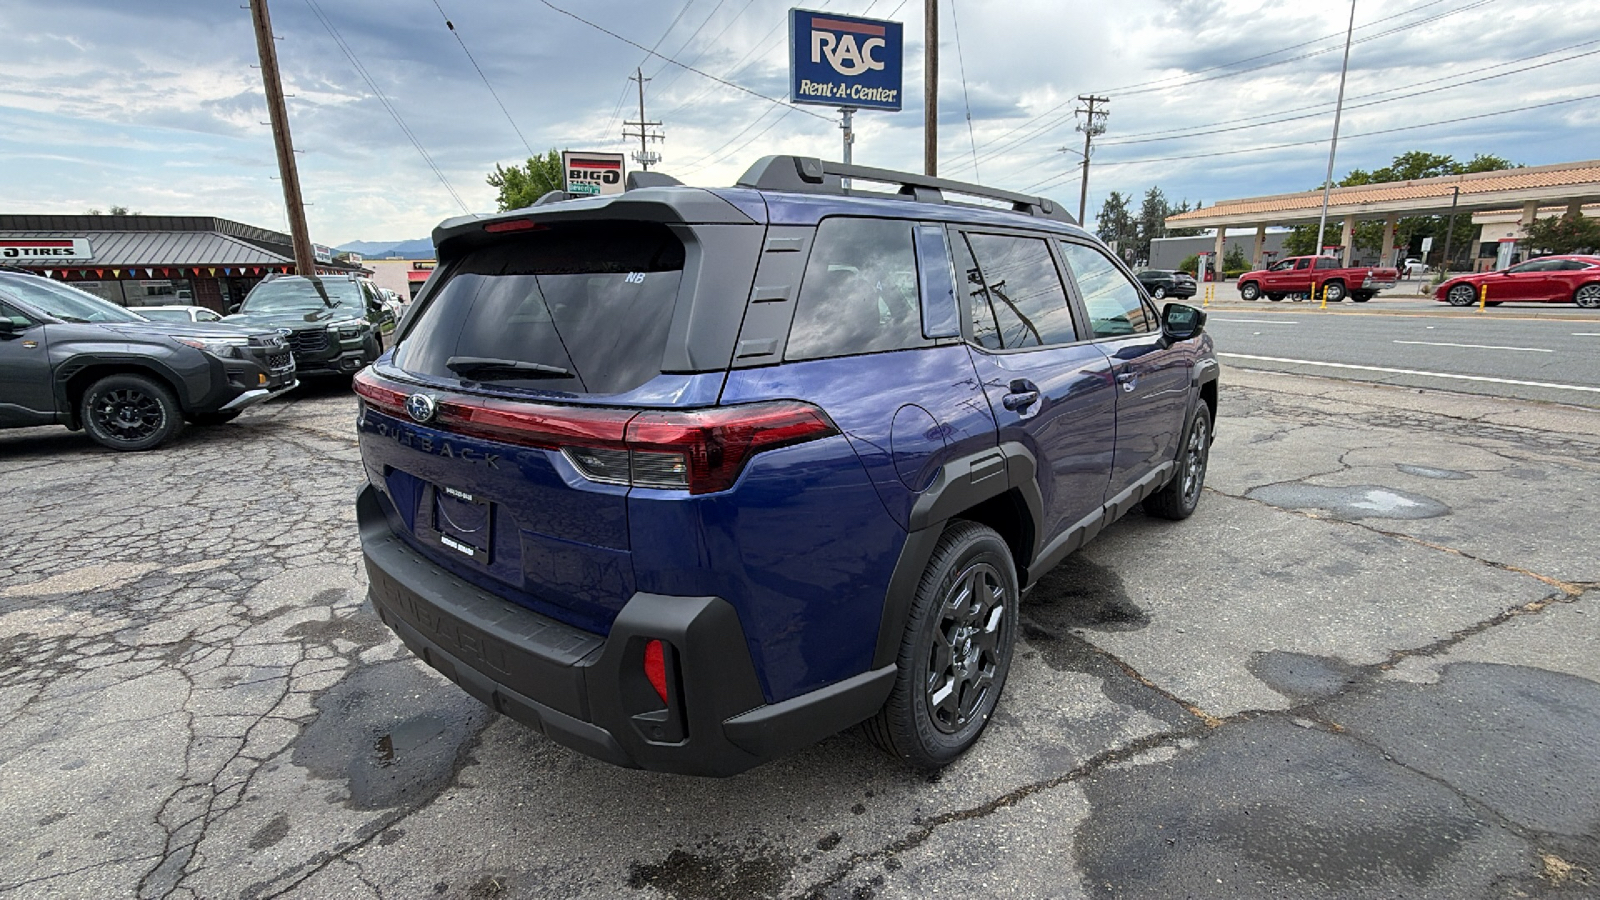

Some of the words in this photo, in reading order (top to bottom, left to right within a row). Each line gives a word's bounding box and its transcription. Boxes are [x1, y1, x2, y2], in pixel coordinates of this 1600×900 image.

[811, 29, 886, 76] RAC
[20, 248, 75, 256] TIRES
[625, 271, 646, 284] NB
[377, 422, 501, 470] OUTBACK
